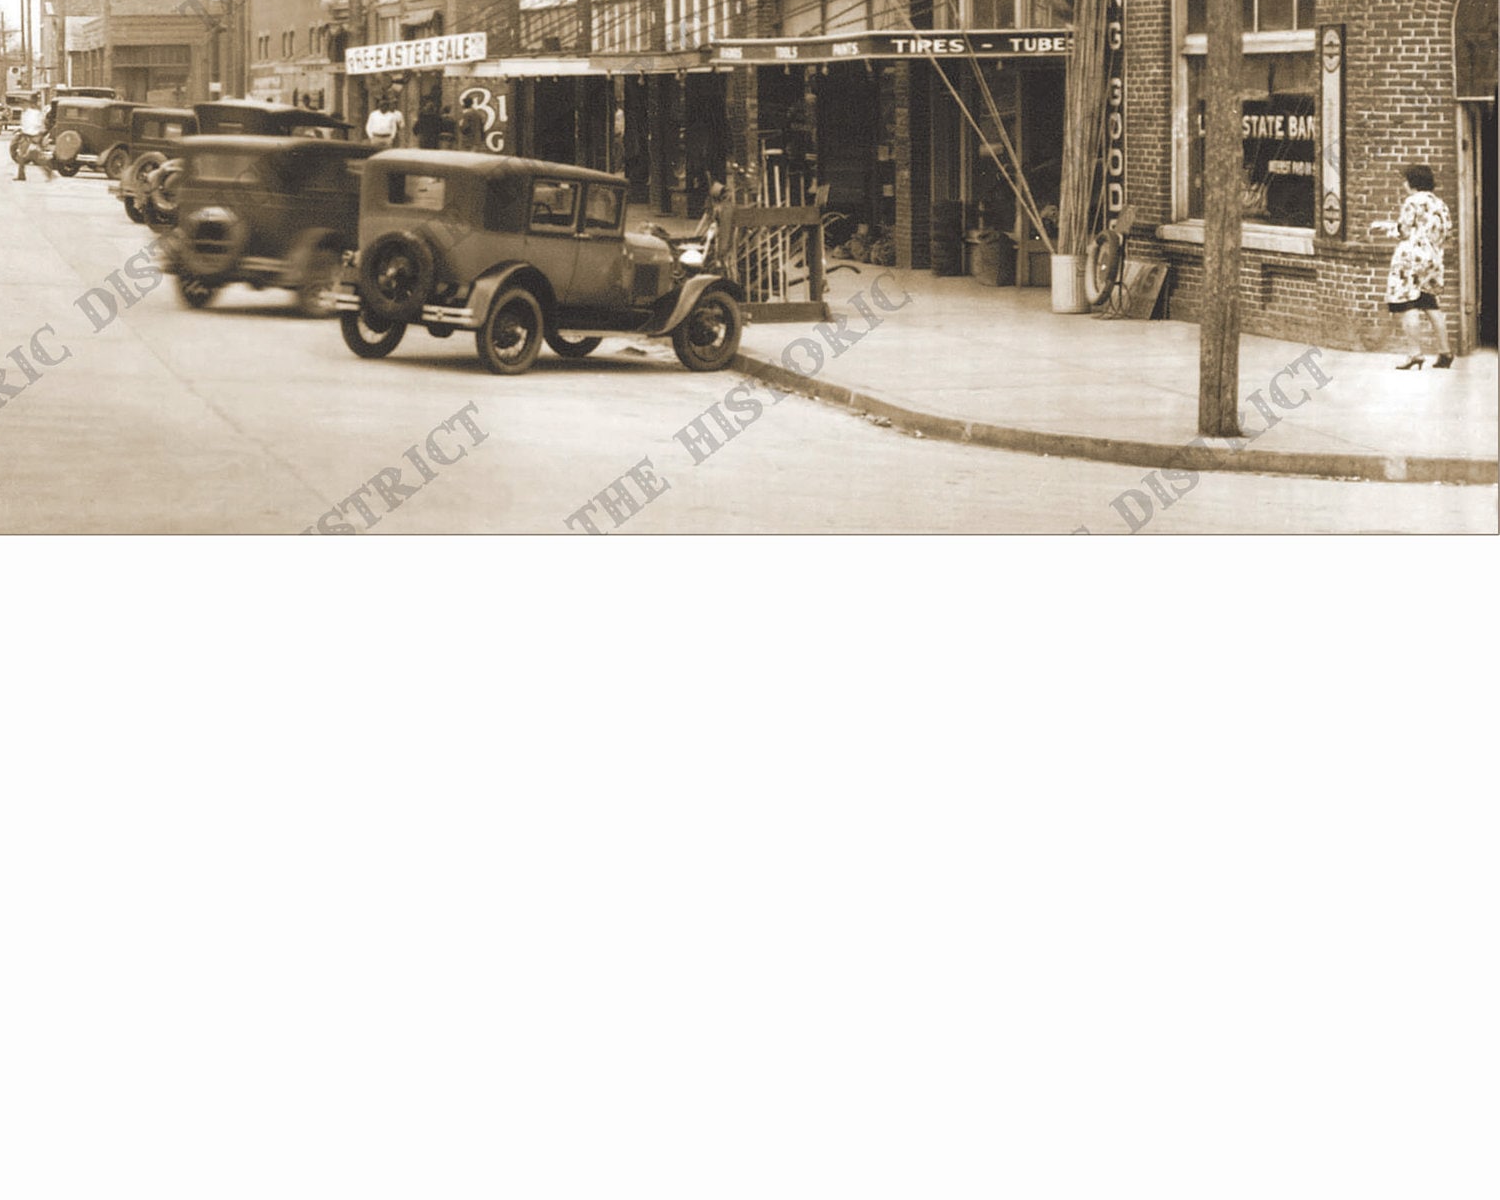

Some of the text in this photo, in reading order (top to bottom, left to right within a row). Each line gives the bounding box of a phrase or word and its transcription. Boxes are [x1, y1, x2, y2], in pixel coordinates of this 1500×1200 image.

[437, 36, 470, 62] SALE
[890, 37, 965, 53] TIRES
[1241, 114, 1315, 140] STATE BAN
